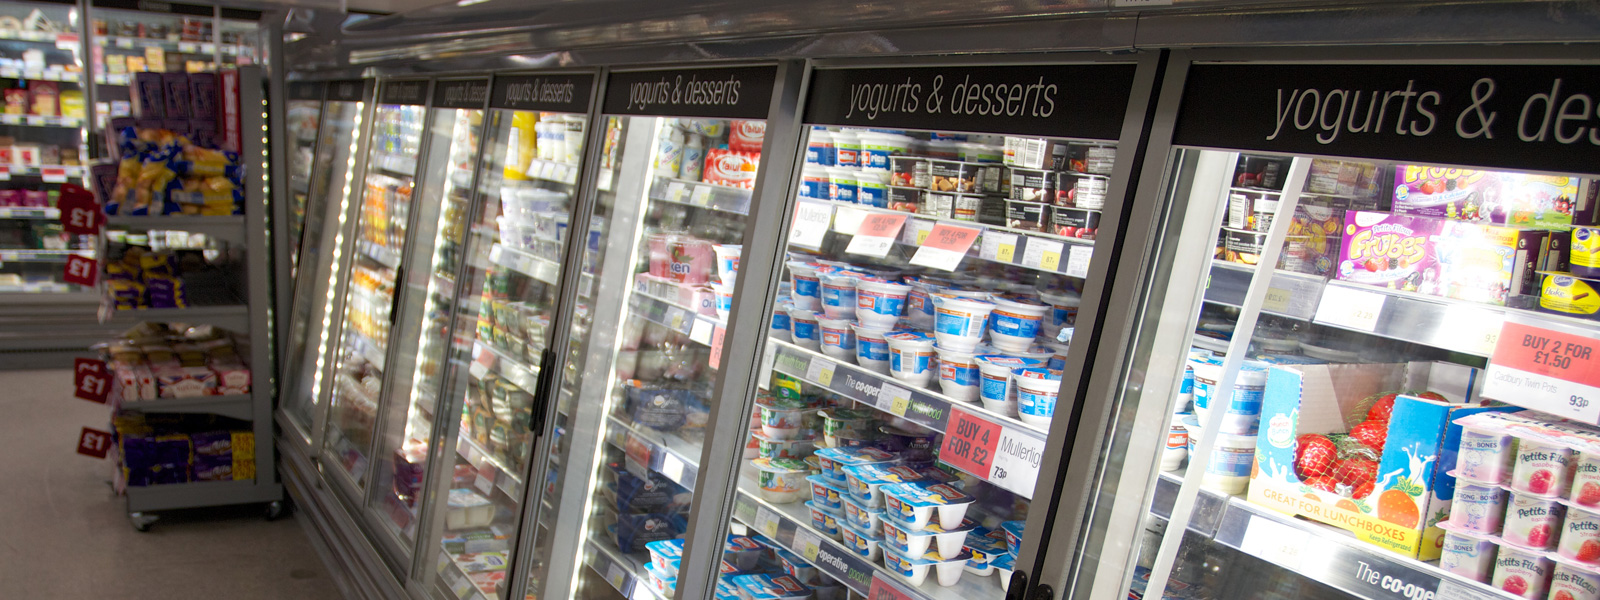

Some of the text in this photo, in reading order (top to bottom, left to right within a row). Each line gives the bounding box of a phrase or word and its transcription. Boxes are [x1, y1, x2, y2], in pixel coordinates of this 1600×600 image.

[504, 79, 574, 105] yogurts & desserts
[627, 75, 740, 110] yogurts & desserts
[846, 74, 1057, 120] yogurts & desserts
[1266, 80, 1440, 144] yogurts
[1456, 77, 1496, 139] &
[71, 207, 95, 229] £1
[68, 258, 92, 279] £1
[1522, 334, 1592, 360] BUY 2 FOR
[1534, 350, 1571, 369] £1.50
[81, 374, 105, 396] £1
[845, 374, 856, 388] The
[1494, 370, 1558, 394] Cadbury Twin Pots
[1569, 395, 1589, 408] 93p
[81, 432, 104, 451] £1
[956, 418, 991, 446] BUY 4
[948, 436, 988, 466] FOR £2
[1001, 436, 1042, 468] Mullerlig
[1520, 452, 1548, 464] Petits
[994, 466, 1007, 479] 73p
[1263, 488, 1406, 542] GREAT FOR LUNCHBOXES
[1517, 506, 1547, 519] Petits
[1568, 521, 1599, 533] Petits
[1369, 533, 1411, 552] Keep Refrigerated
[1356, 560, 1380, 585] The
[1571, 574, 1597, 594] Filous
